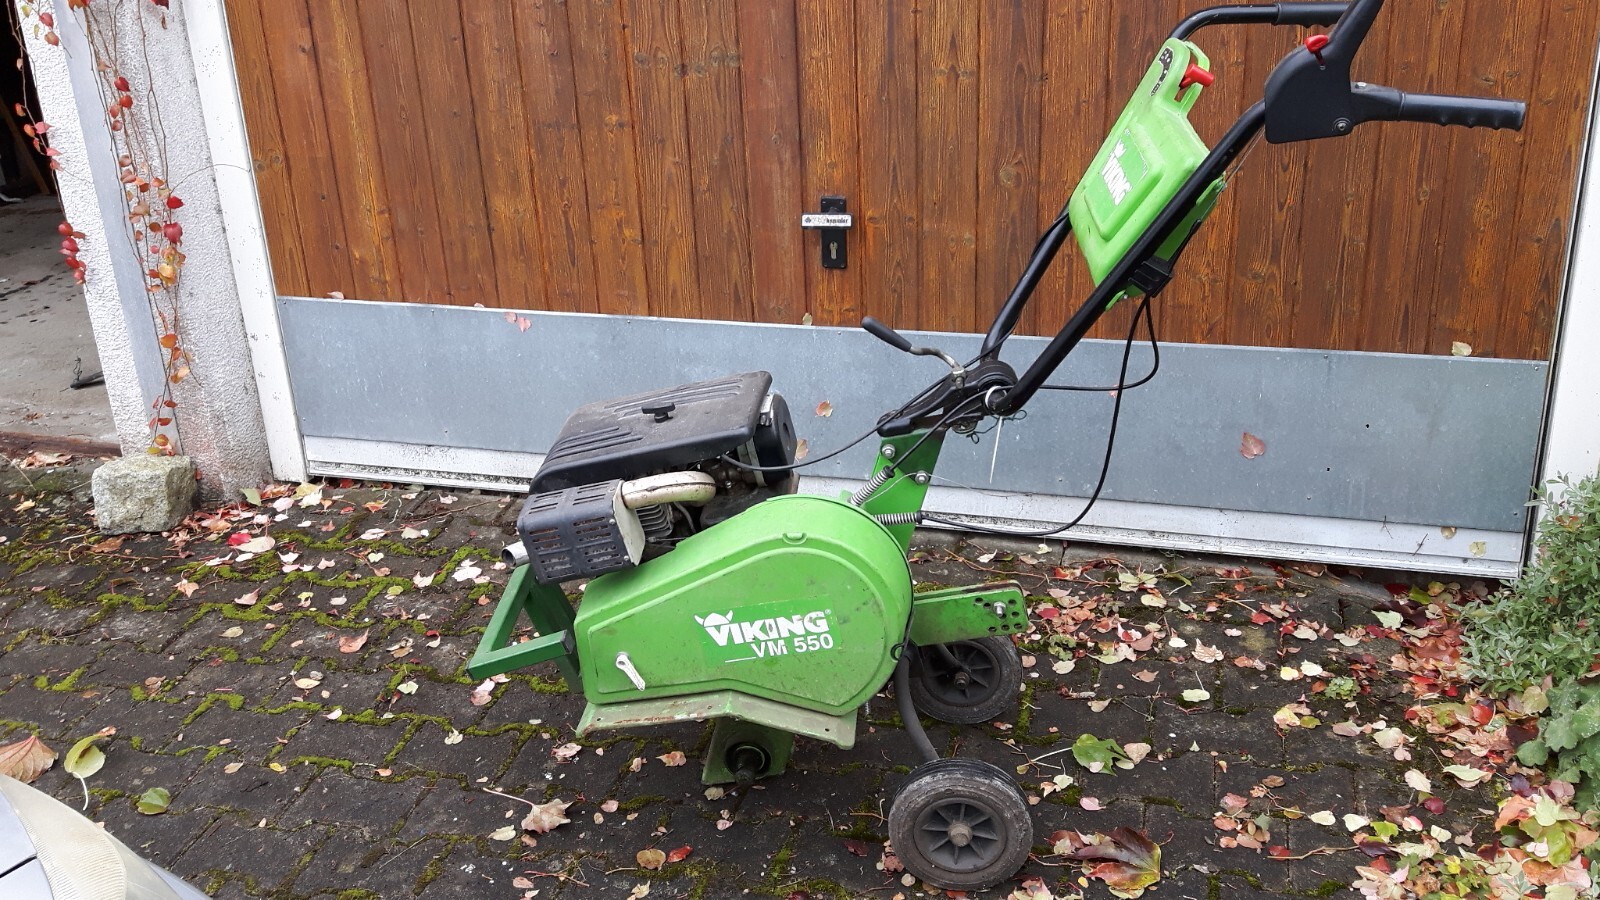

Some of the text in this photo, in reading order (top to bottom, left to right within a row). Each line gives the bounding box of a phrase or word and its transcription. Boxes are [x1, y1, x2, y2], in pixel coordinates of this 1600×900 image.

[705, 611, 830, 646] VIKING
[750, 633, 834, 658] VM 550
